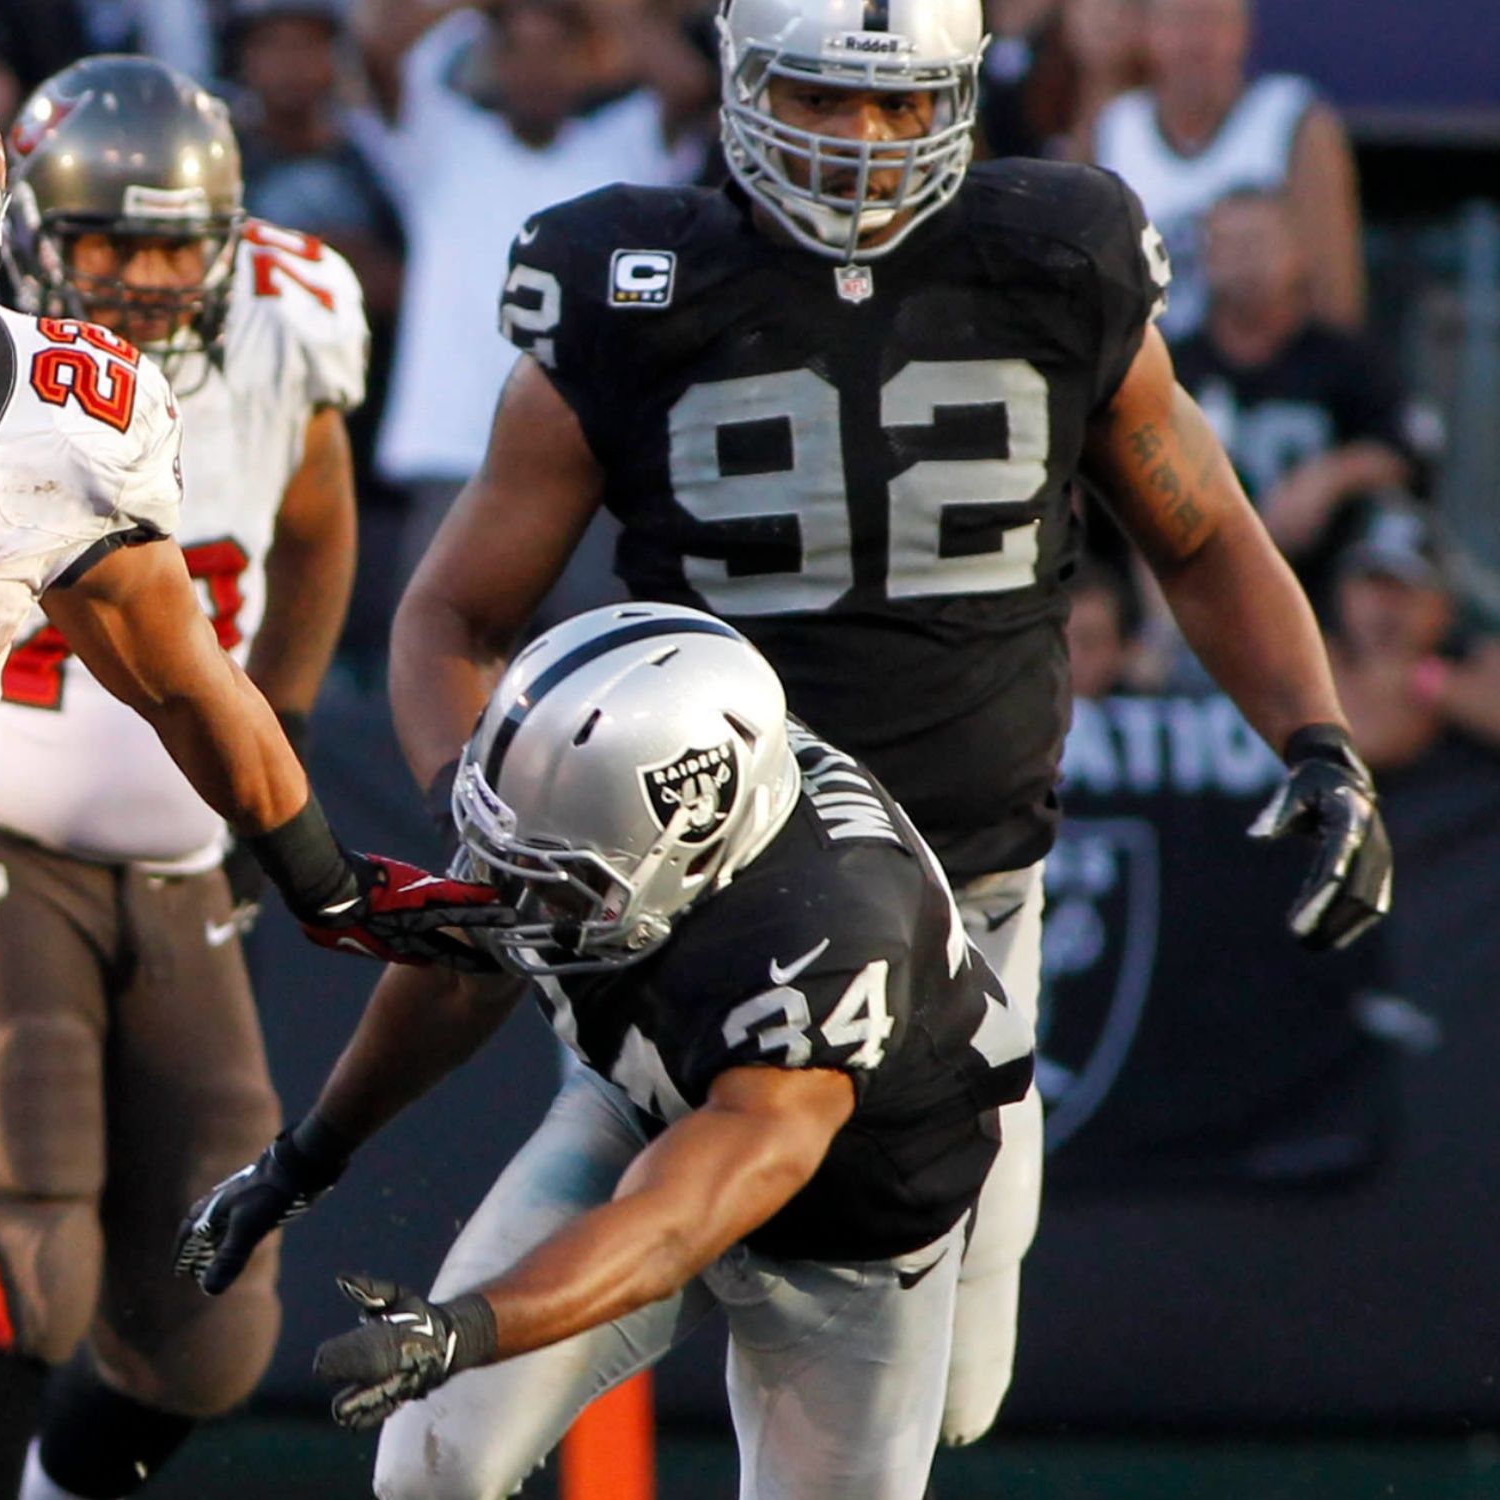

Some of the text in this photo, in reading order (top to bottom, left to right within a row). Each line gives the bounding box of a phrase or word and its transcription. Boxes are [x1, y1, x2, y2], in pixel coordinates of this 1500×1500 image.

[846, 36, 898, 52] Riddell
[616, 254, 670, 291] C
[668, 359, 1049, 615] 92
[653, 743, 731, 785] RAIDERS
[786, 718, 902, 842] MITC
[721, 959, 896, 1070] 34
